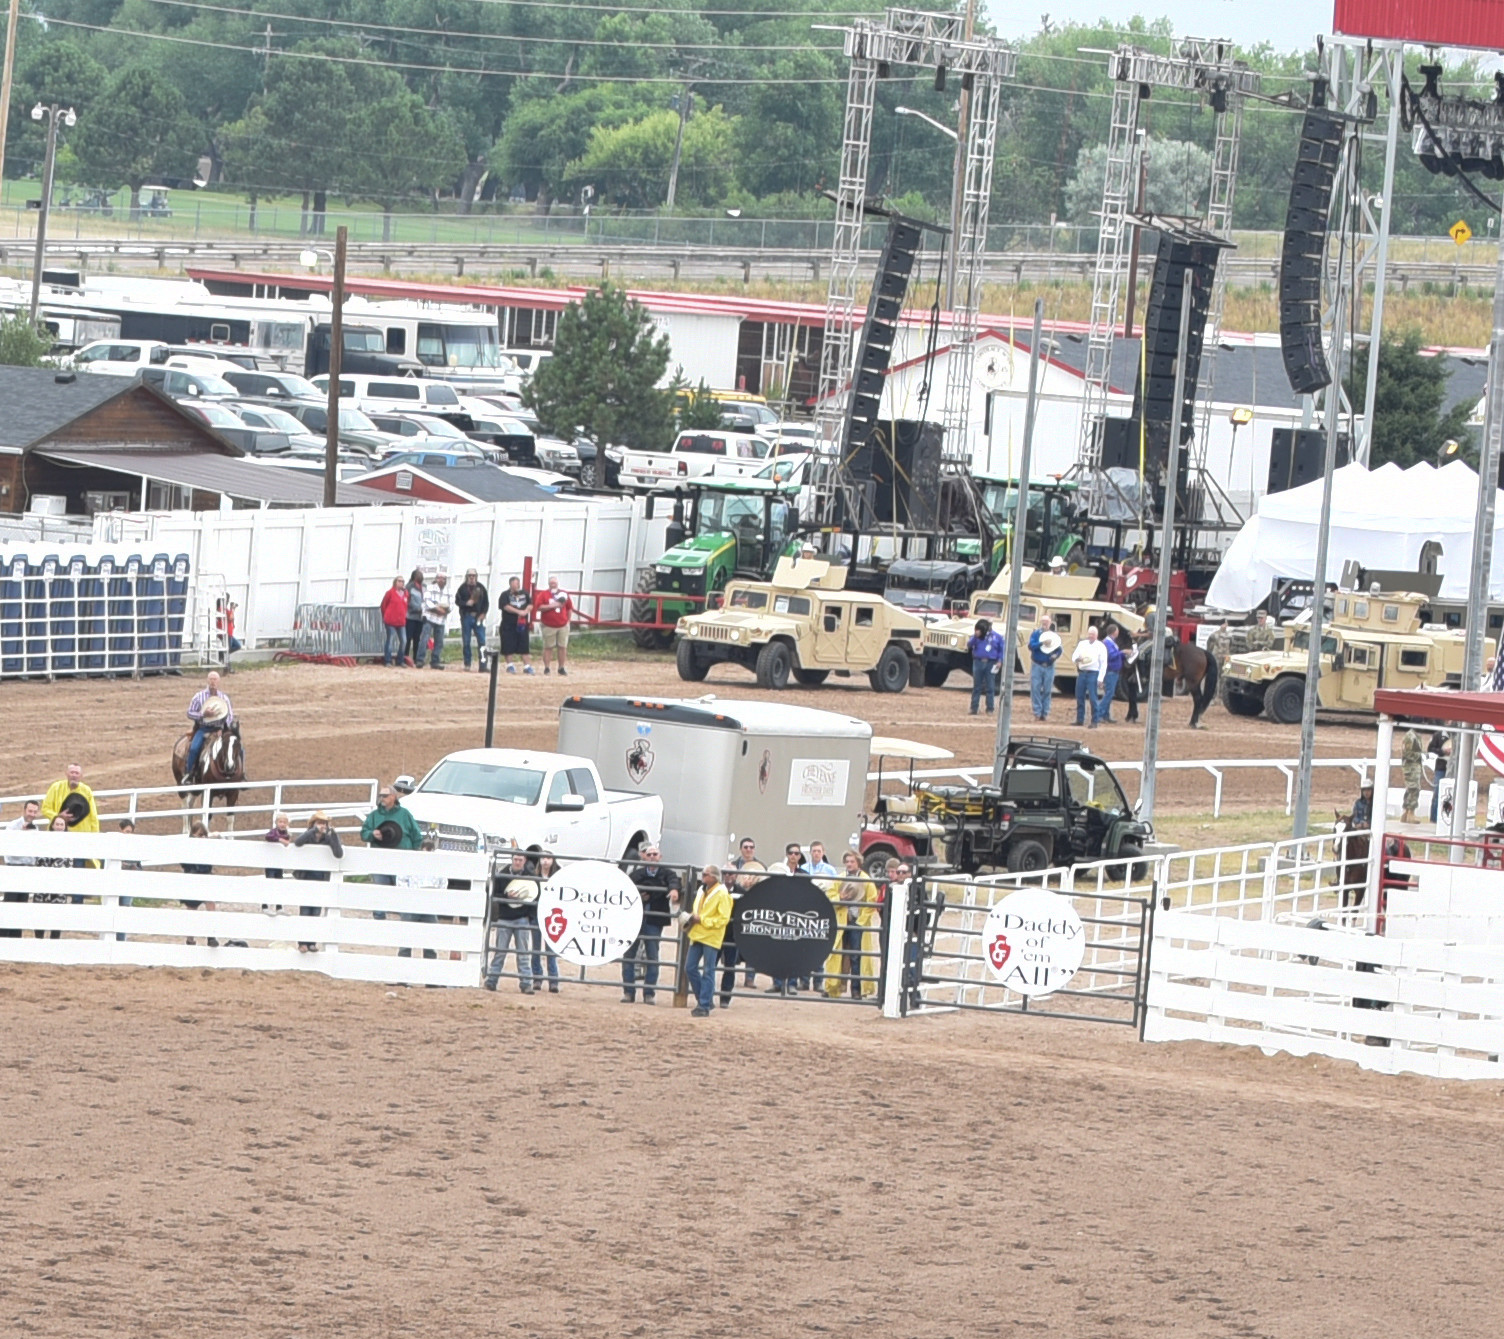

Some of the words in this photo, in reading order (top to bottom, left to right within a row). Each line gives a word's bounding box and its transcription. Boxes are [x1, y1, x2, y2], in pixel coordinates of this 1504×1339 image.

[583, 907, 608, 920] of
[741, 909, 830, 930] CHEYENNE
[742, 923, 796, 937] FRONTIER
[799, 927, 827, 939] DAYS
[1025, 935, 1051, 949] of
